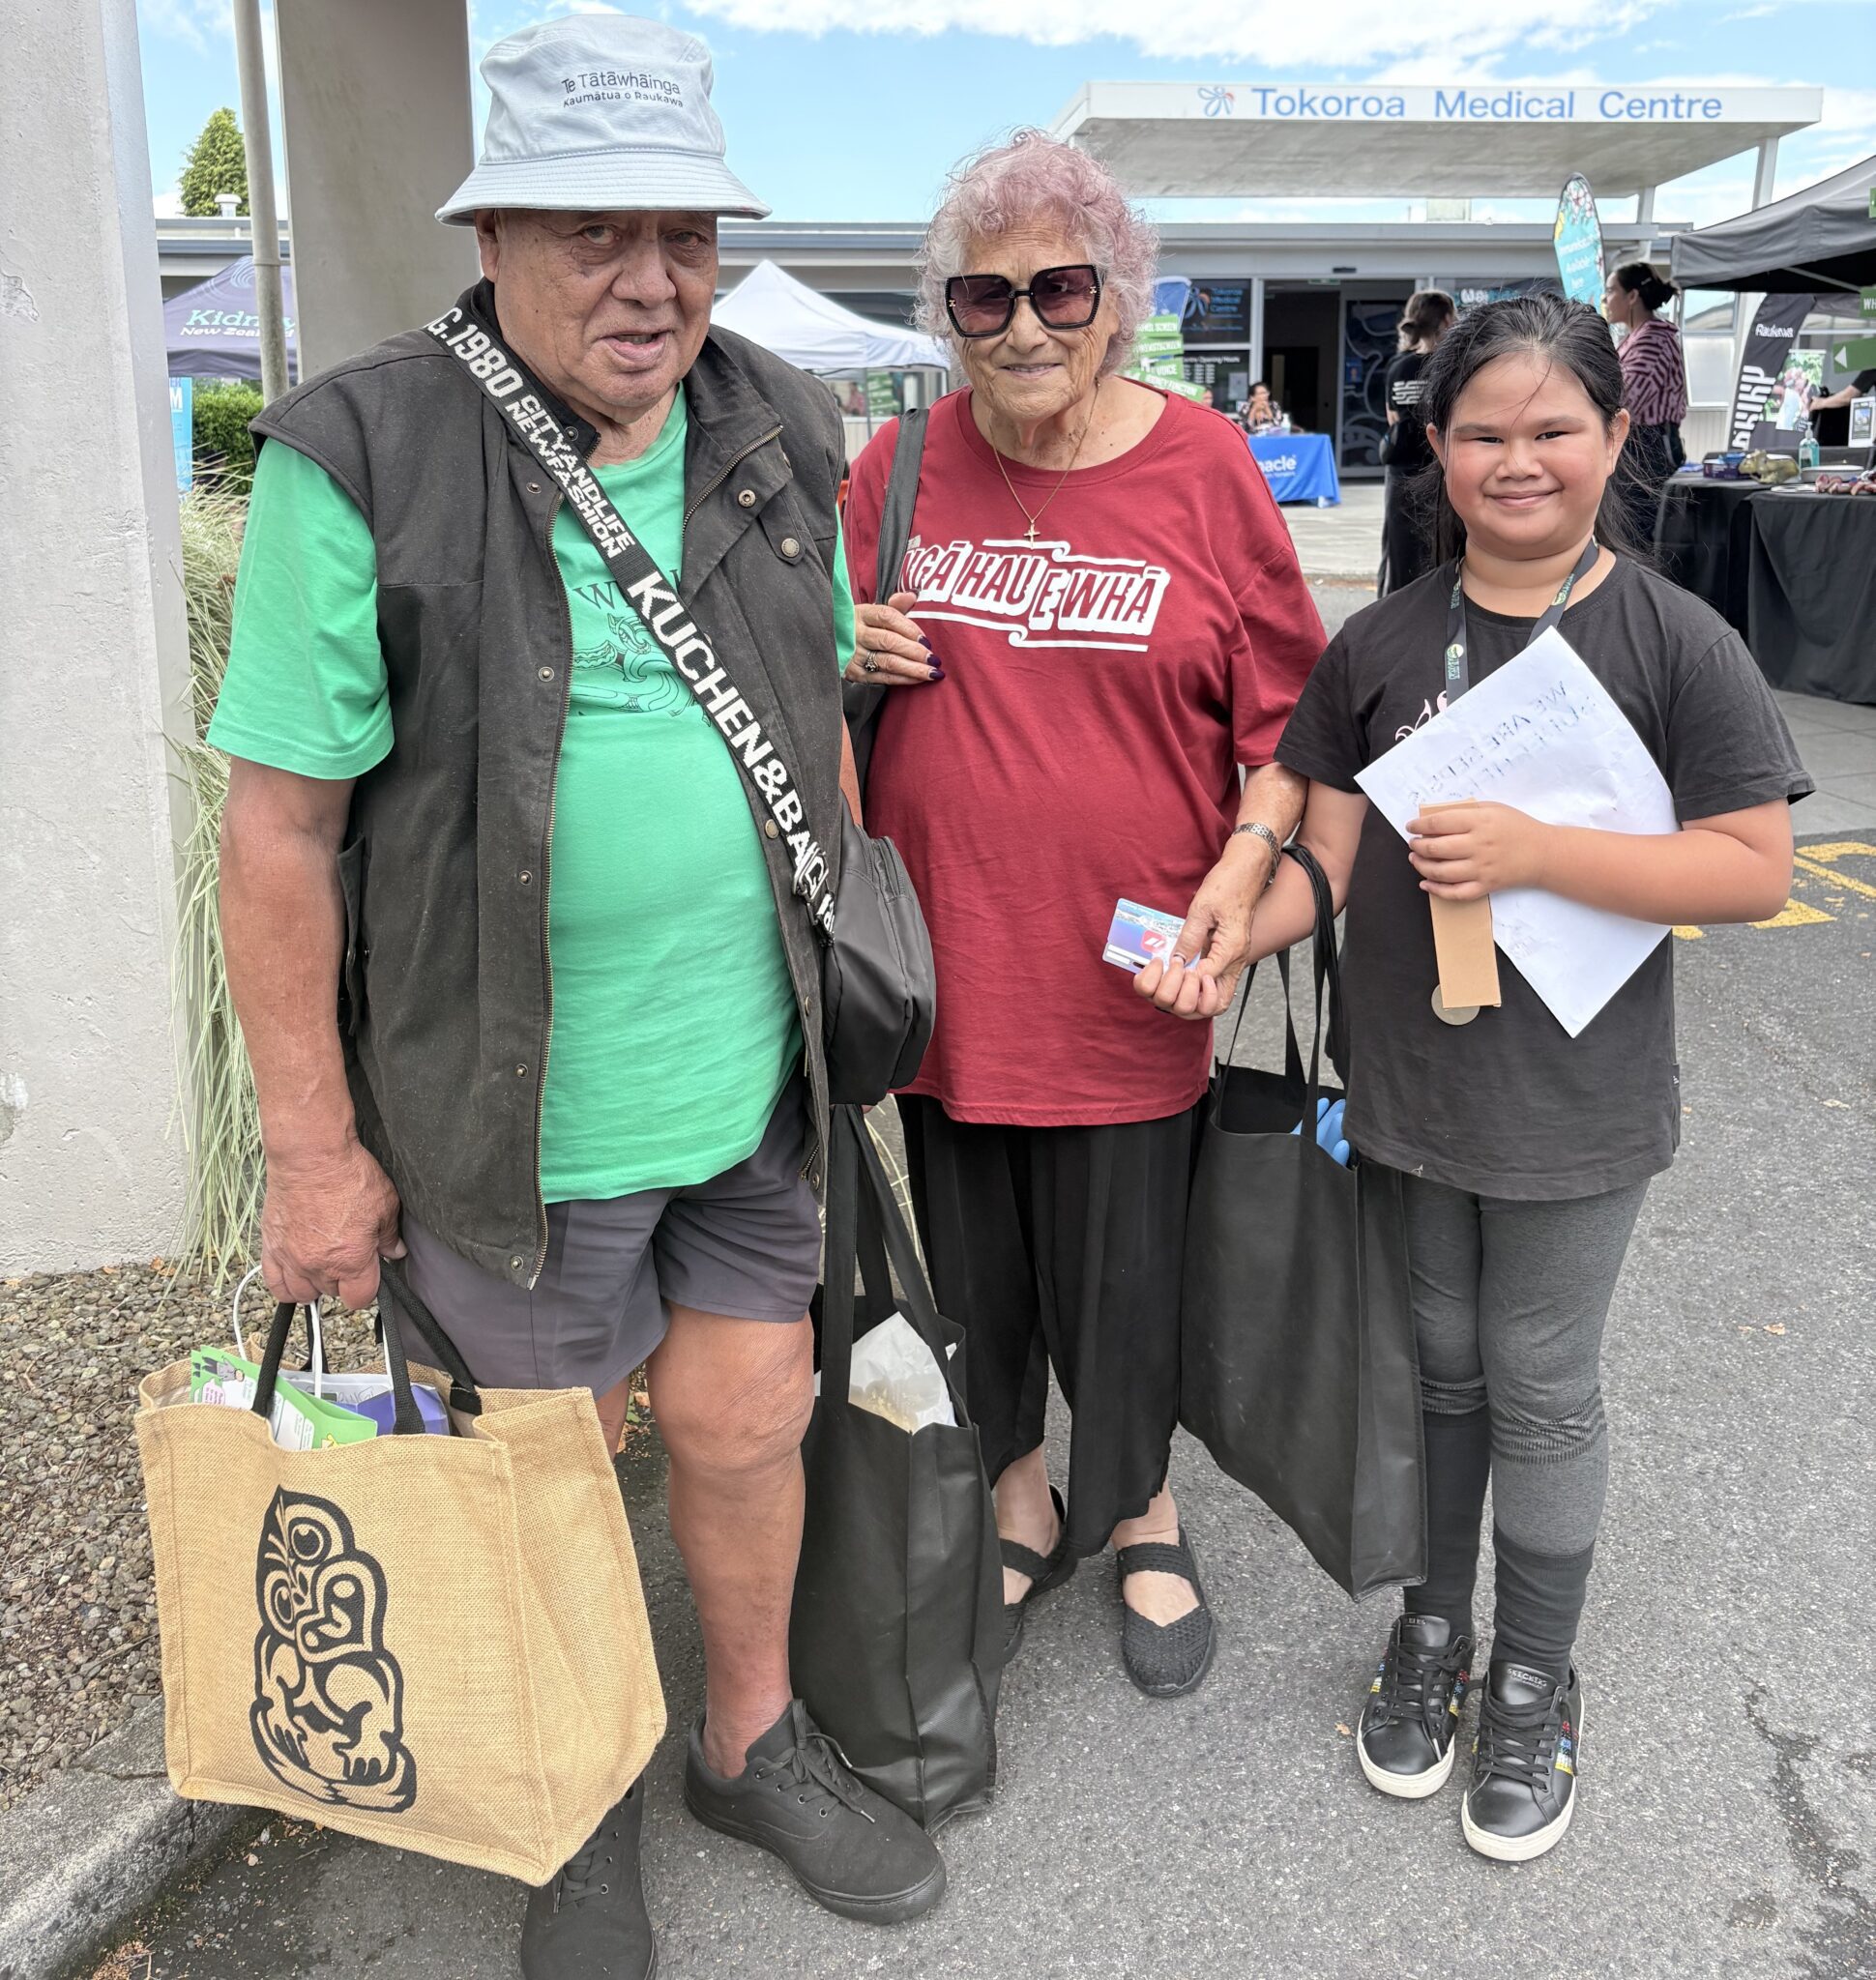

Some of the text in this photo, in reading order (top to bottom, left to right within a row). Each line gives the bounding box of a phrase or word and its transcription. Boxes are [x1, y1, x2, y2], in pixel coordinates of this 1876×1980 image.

[561, 78, 576, 94] Te
[563, 92, 621, 108] Kaumātua
[634, 92, 684, 107] Raukawa
[1251, 88, 1722, 119] Tokoroa Medical Centre
[180, 327, 295, 337] New Zeald
[186, 309, 295, 330] Kidny
[505, 400, 622, 559] NEWFASHION
[520, 394, 635, 552] CITYANDLIFE
[951, 551, 1049, 616] HAU
[1028, 568, 1070, 630] E
[1058, 566, 1171, 635] WHĀ
